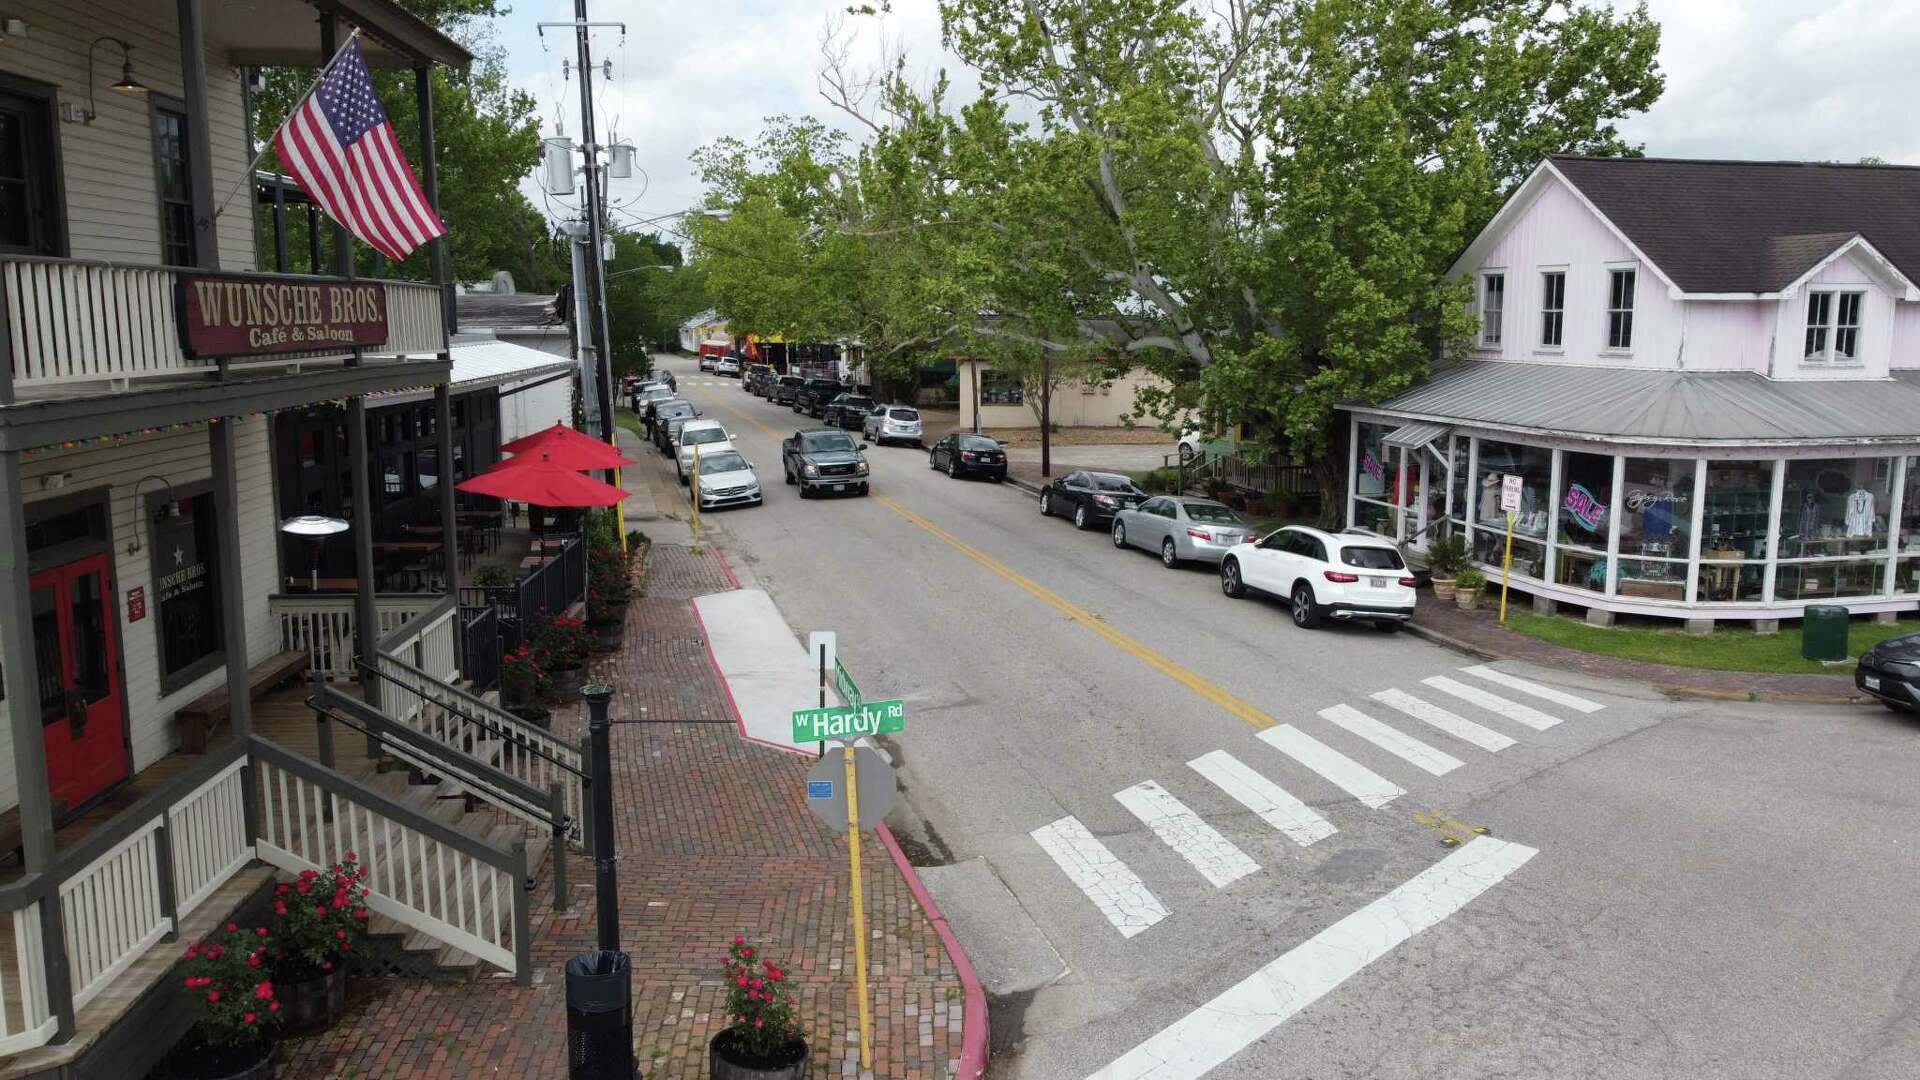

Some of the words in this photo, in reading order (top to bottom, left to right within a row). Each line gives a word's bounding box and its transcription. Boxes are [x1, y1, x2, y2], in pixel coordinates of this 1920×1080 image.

[194, 280, 322, 327] WUNSCHE
[329, 286, 383, 324] BROS.
[249, 327, 287, 348] Café
[292, 328, 304, 343] &
[307, 325, 354, 342] Saloon
[1567, 487, 1604, 526] SALE
[795, 714, 809, 727] W
[812, 706, 882, 736] Hardy
[888, 703, 903, 717] Rd
